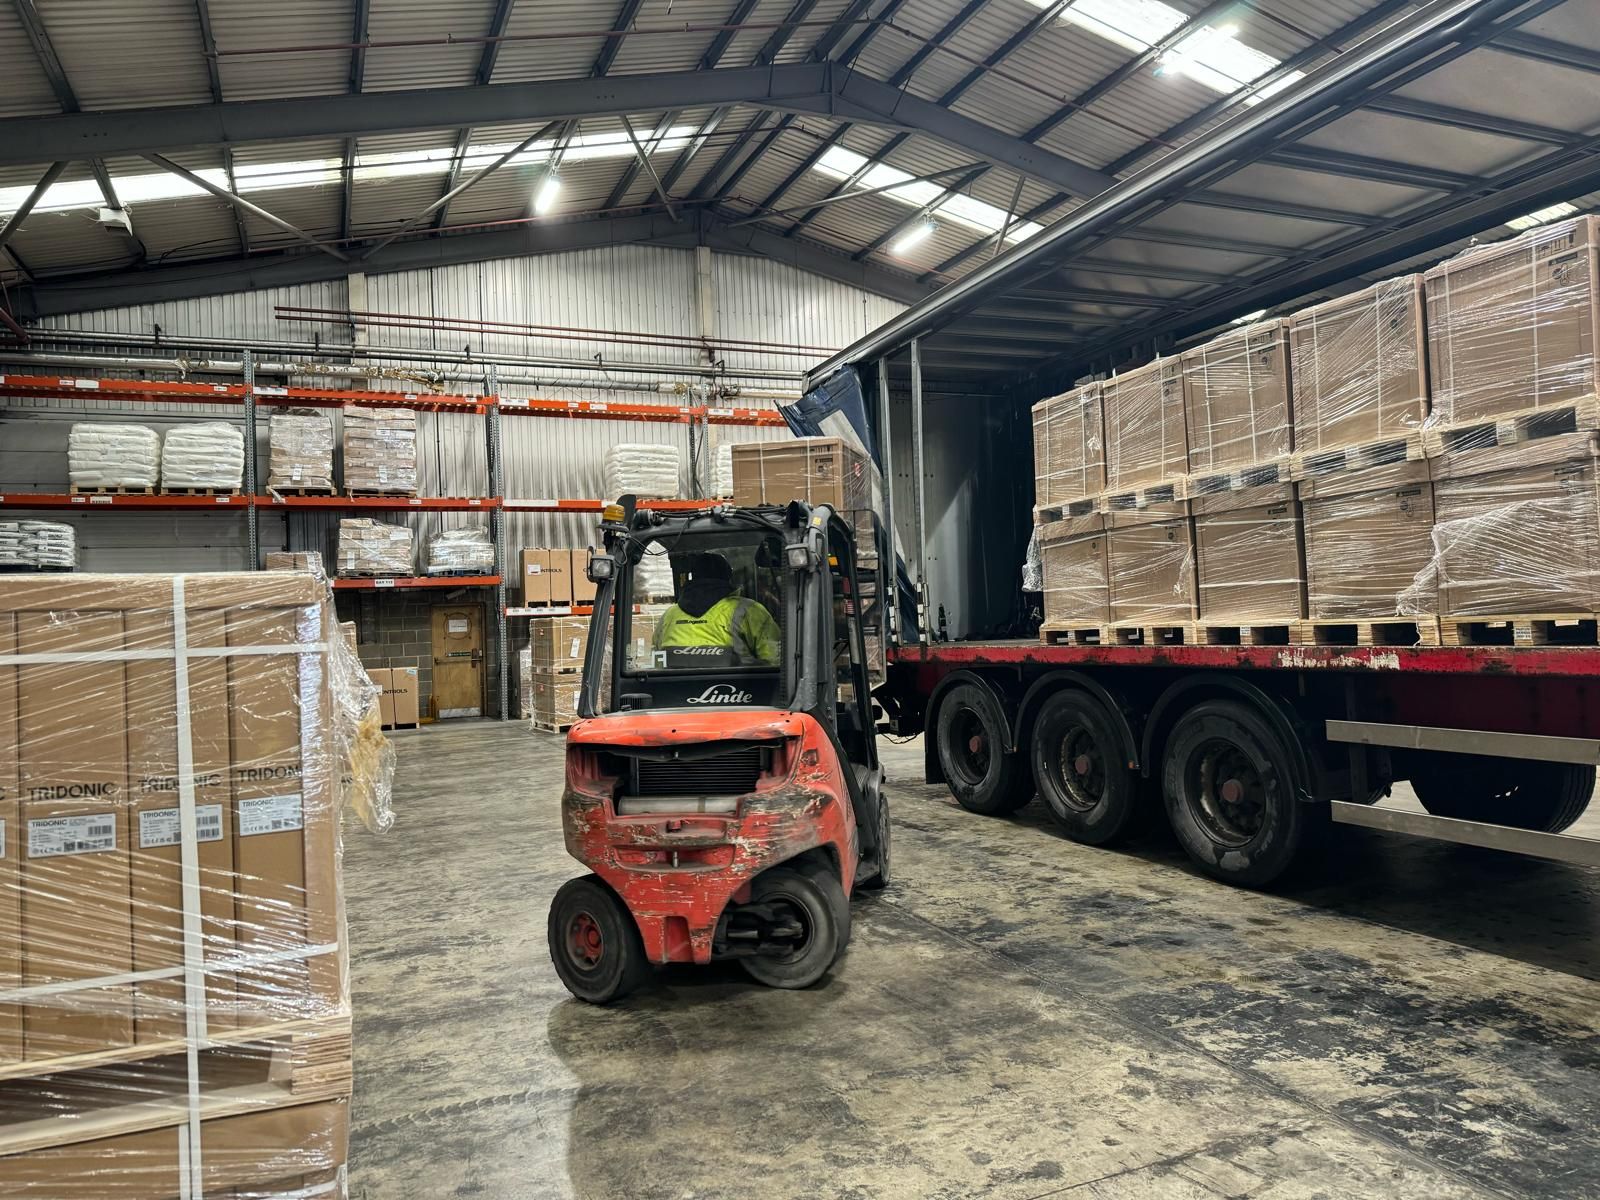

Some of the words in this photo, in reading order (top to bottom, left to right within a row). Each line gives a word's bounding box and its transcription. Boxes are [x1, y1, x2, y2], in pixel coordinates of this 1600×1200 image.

[673, 646, 724, 655] Linde
[687, 684, 753, 703] Linde
[237, 765, 300, 783] TRIDON
[138, 774, 222, 793] TRIDNIC
[27, 782, 119, 802] TRIDONIC
[242, 799, 274, 808] TRIDONIC
[143, 810, 177, 818] TRIDONIC
[32, 819, 67, 827] TRIDONIC
